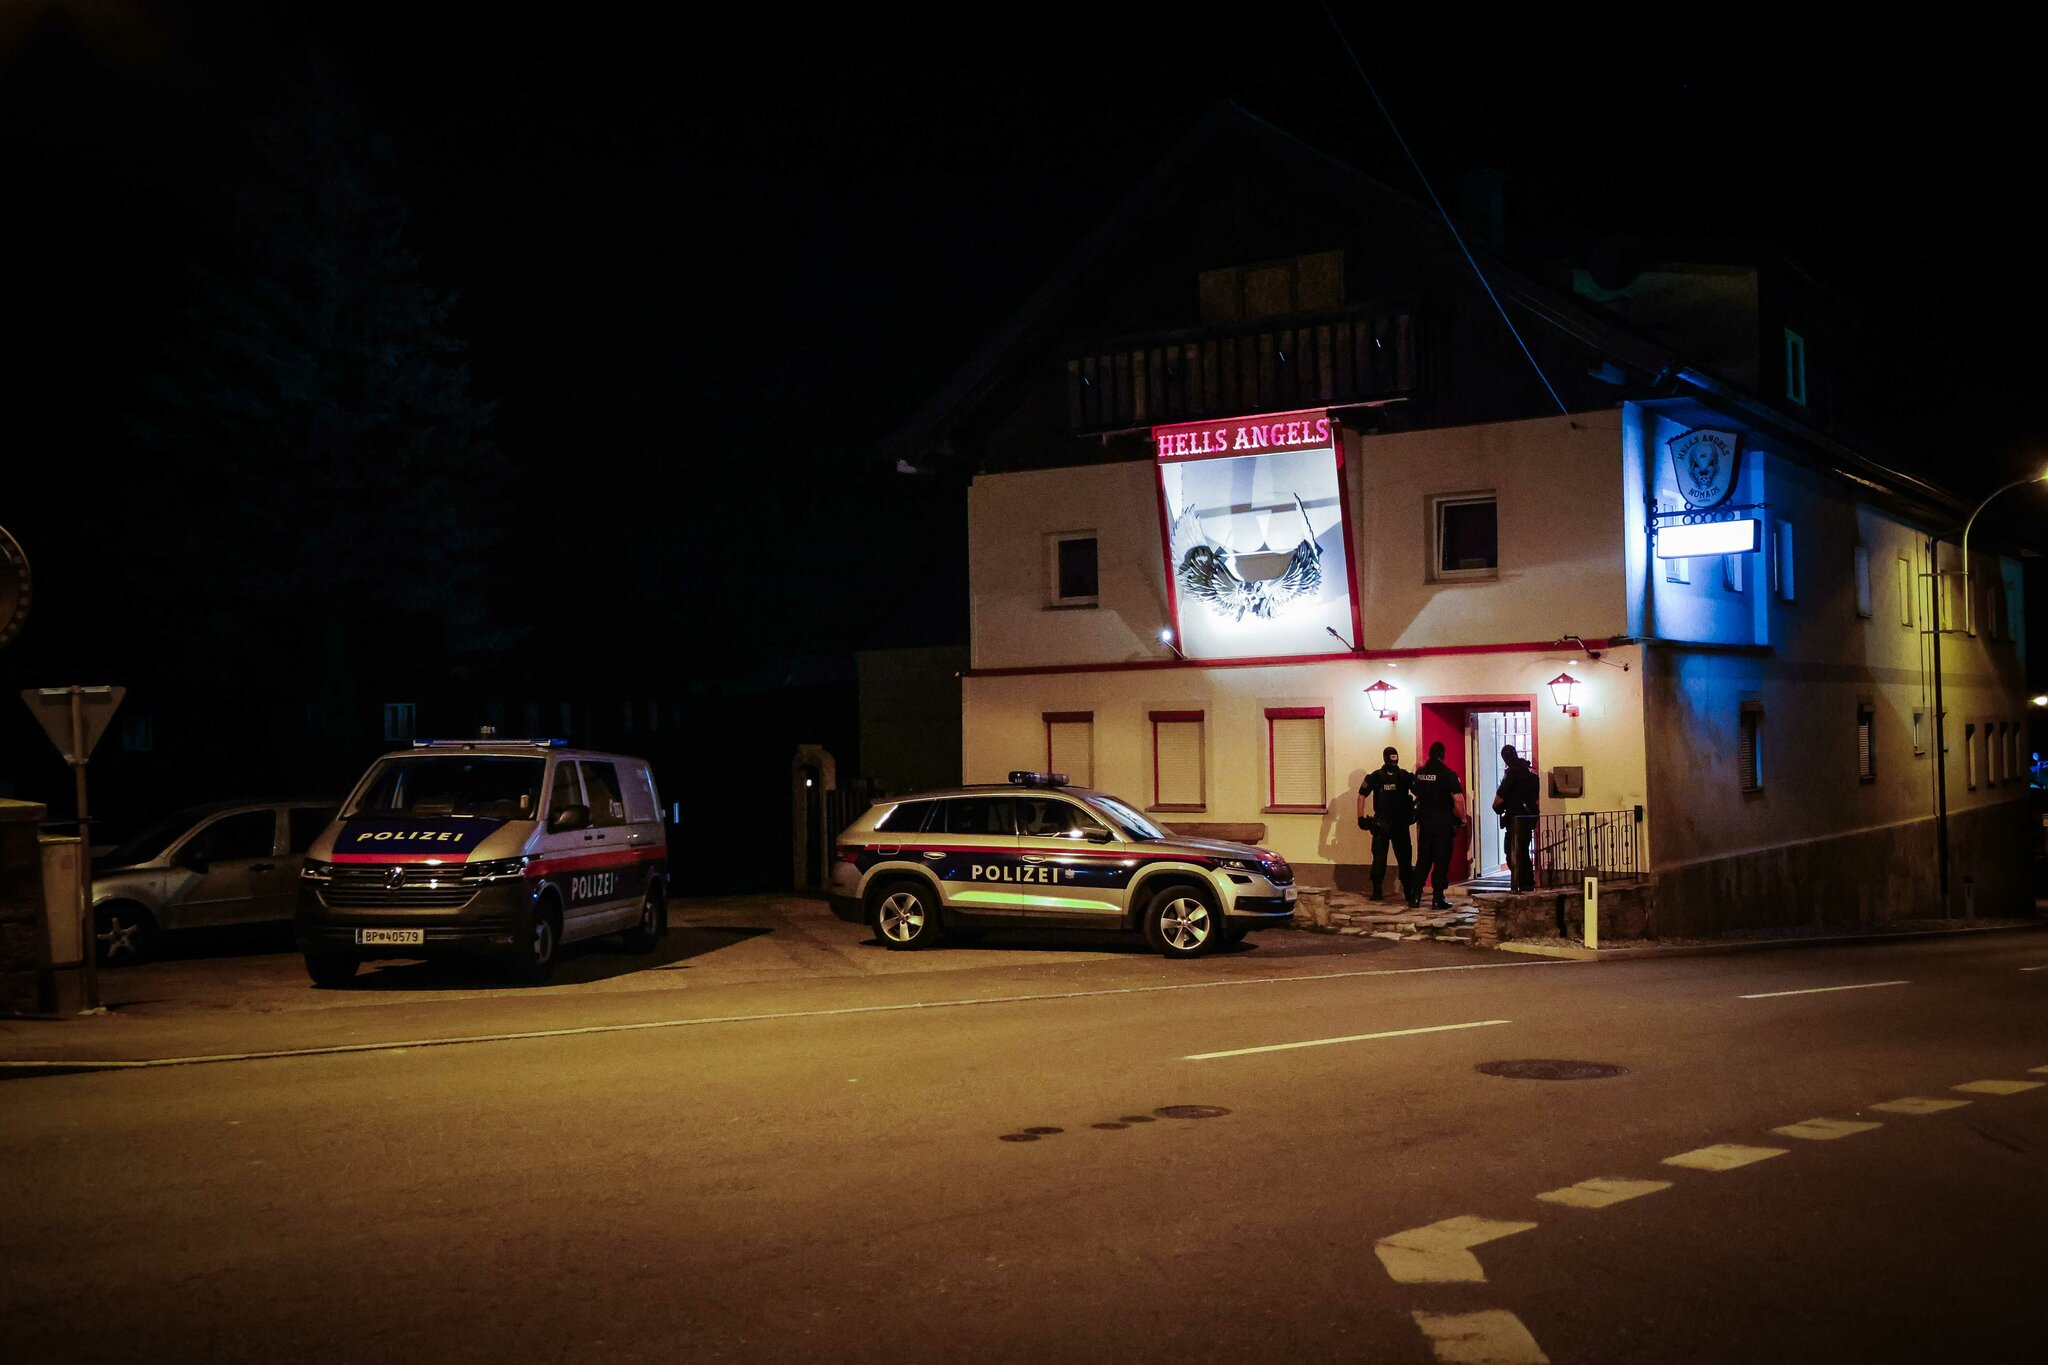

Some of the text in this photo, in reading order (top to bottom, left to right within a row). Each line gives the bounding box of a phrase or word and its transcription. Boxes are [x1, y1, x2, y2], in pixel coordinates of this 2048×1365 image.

[1157, 418, 1329, 457] HELLS ANGELS
[1678, 434, 1730, 460] HELLS ANGELS
[1688, 486, 1720, 498] NOMADS
[357, 831, 464, 842] POLIZEI
[971, 864, 1058, 884] POLIZEI
[571, 871, 614, 901] POLIZEI
[365, 931, 419, 942] BP 40579
